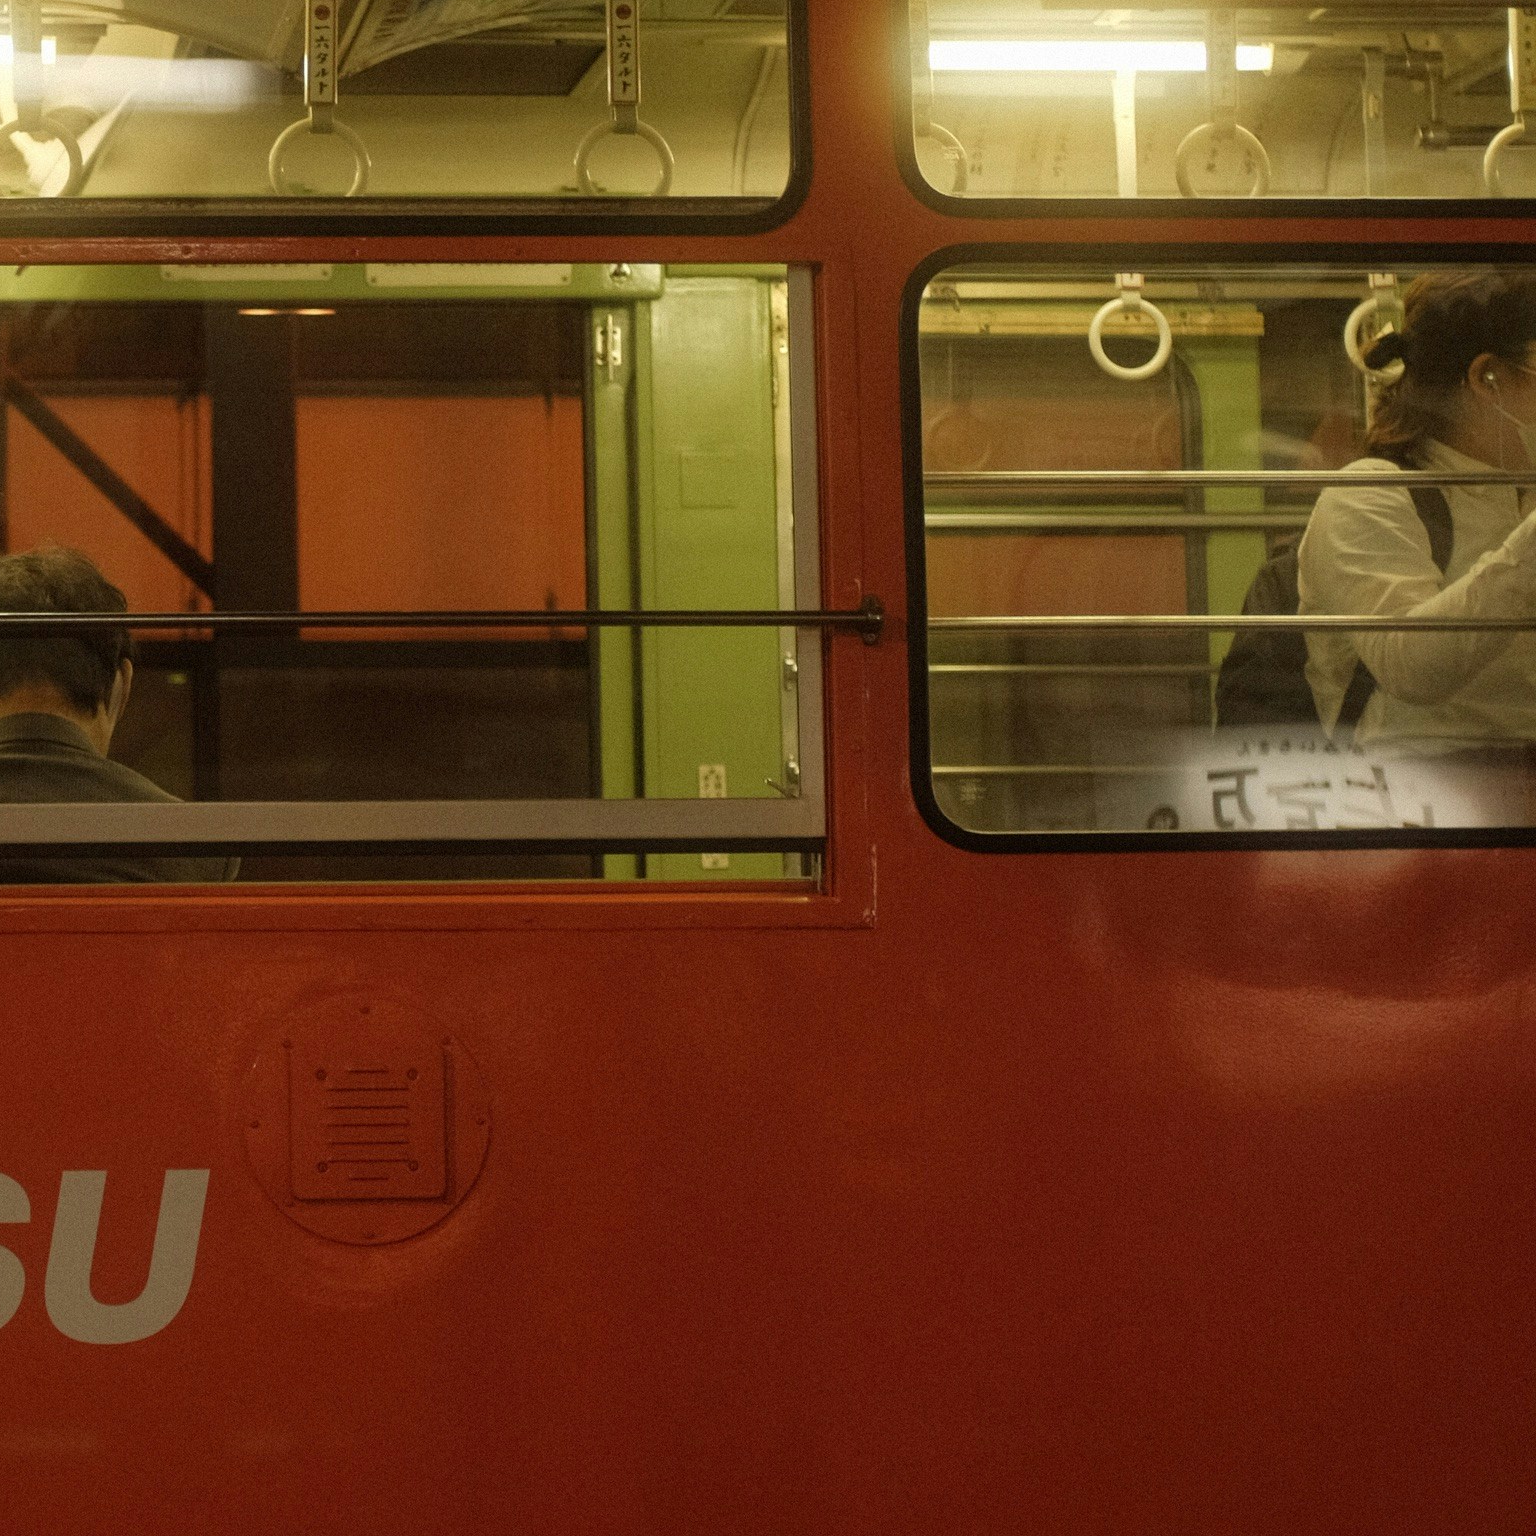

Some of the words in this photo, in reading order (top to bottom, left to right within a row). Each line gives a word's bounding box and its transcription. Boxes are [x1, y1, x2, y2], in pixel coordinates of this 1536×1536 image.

[313, 23, 331, 96] 一六タルト
[615, 23, 633, 95] 一六タルト
